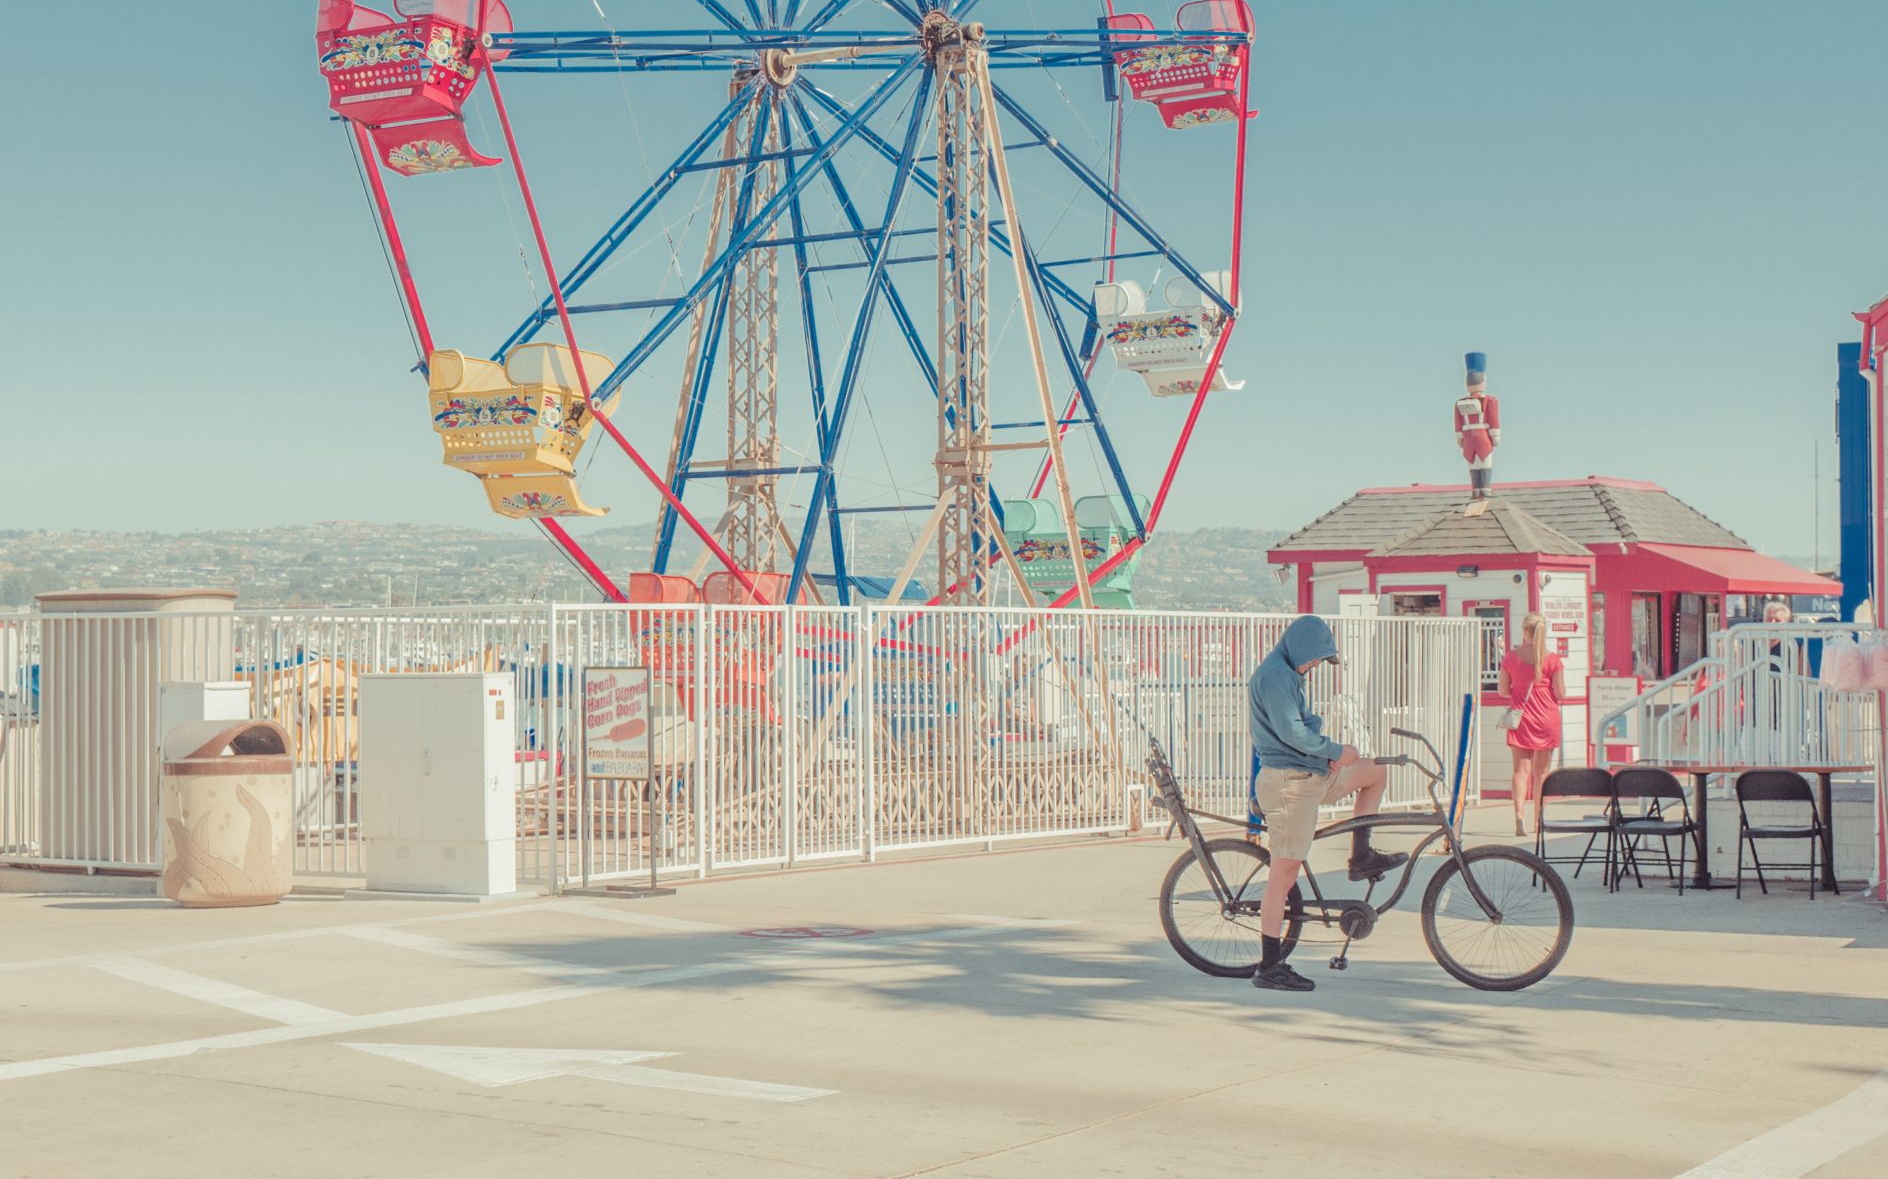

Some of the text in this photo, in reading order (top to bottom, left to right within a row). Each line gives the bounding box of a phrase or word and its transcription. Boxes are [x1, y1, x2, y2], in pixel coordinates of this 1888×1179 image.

[587, 674, 617, 697] Fresh
[587, 678, 647, 713] Hand Dipped
[587, 701, 642, 729] Corn Dogs
[588, 747, 647, 759] Frozen Bananas
[591, 761, 605, 774] and
